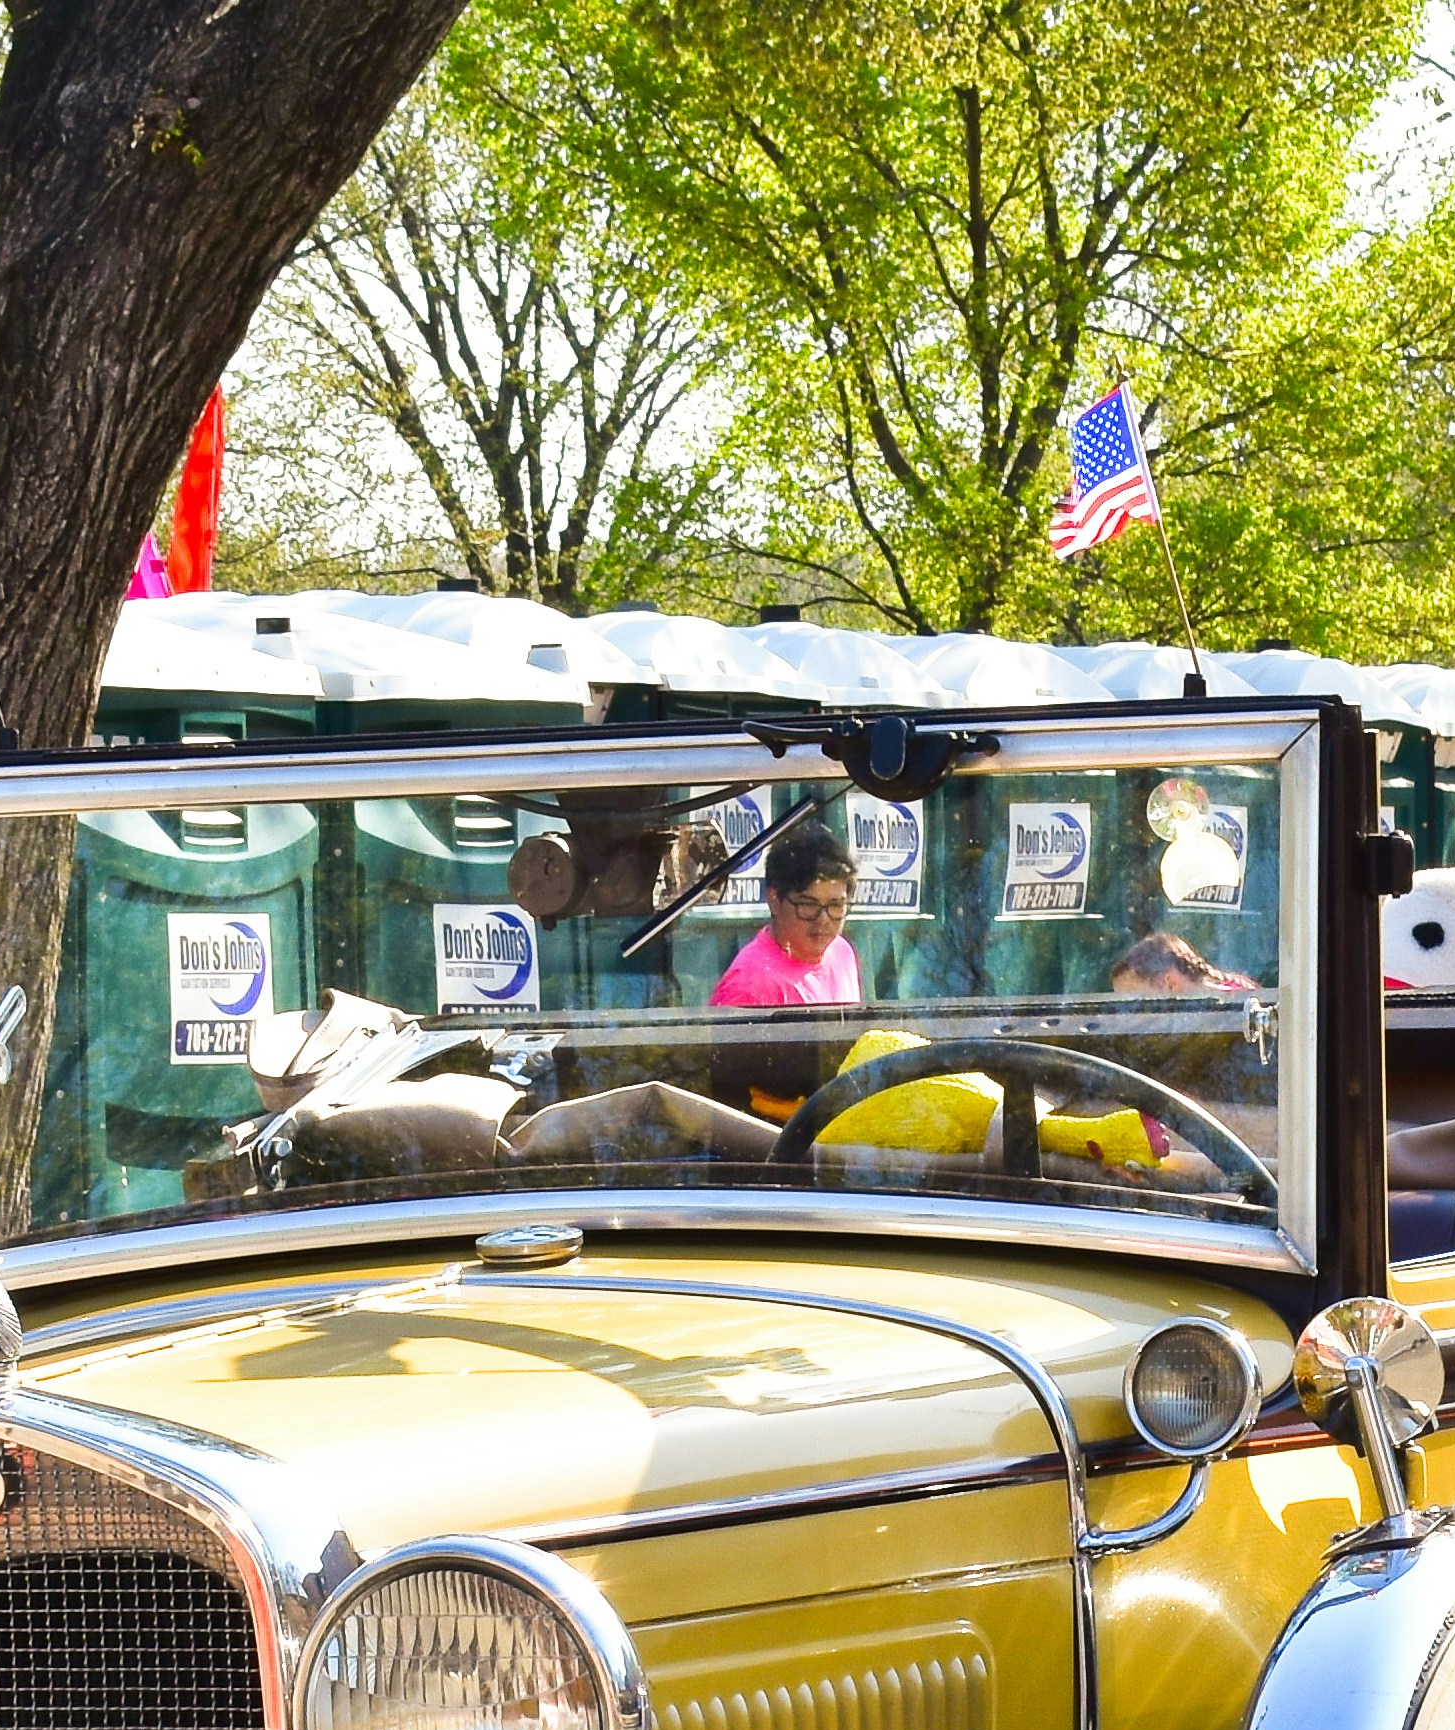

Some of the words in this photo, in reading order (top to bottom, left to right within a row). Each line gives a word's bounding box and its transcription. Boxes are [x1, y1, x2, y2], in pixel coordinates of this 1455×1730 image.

[1016, 823, 1049, 855] Don's
[1050, 824, 1082, 854] Johns
[180, 935, 221, 971] Don's
[224, 934, 261, 971] Johns
[443, 922, 484, 960] Don's
[485, 922, 526, 963] Johns
